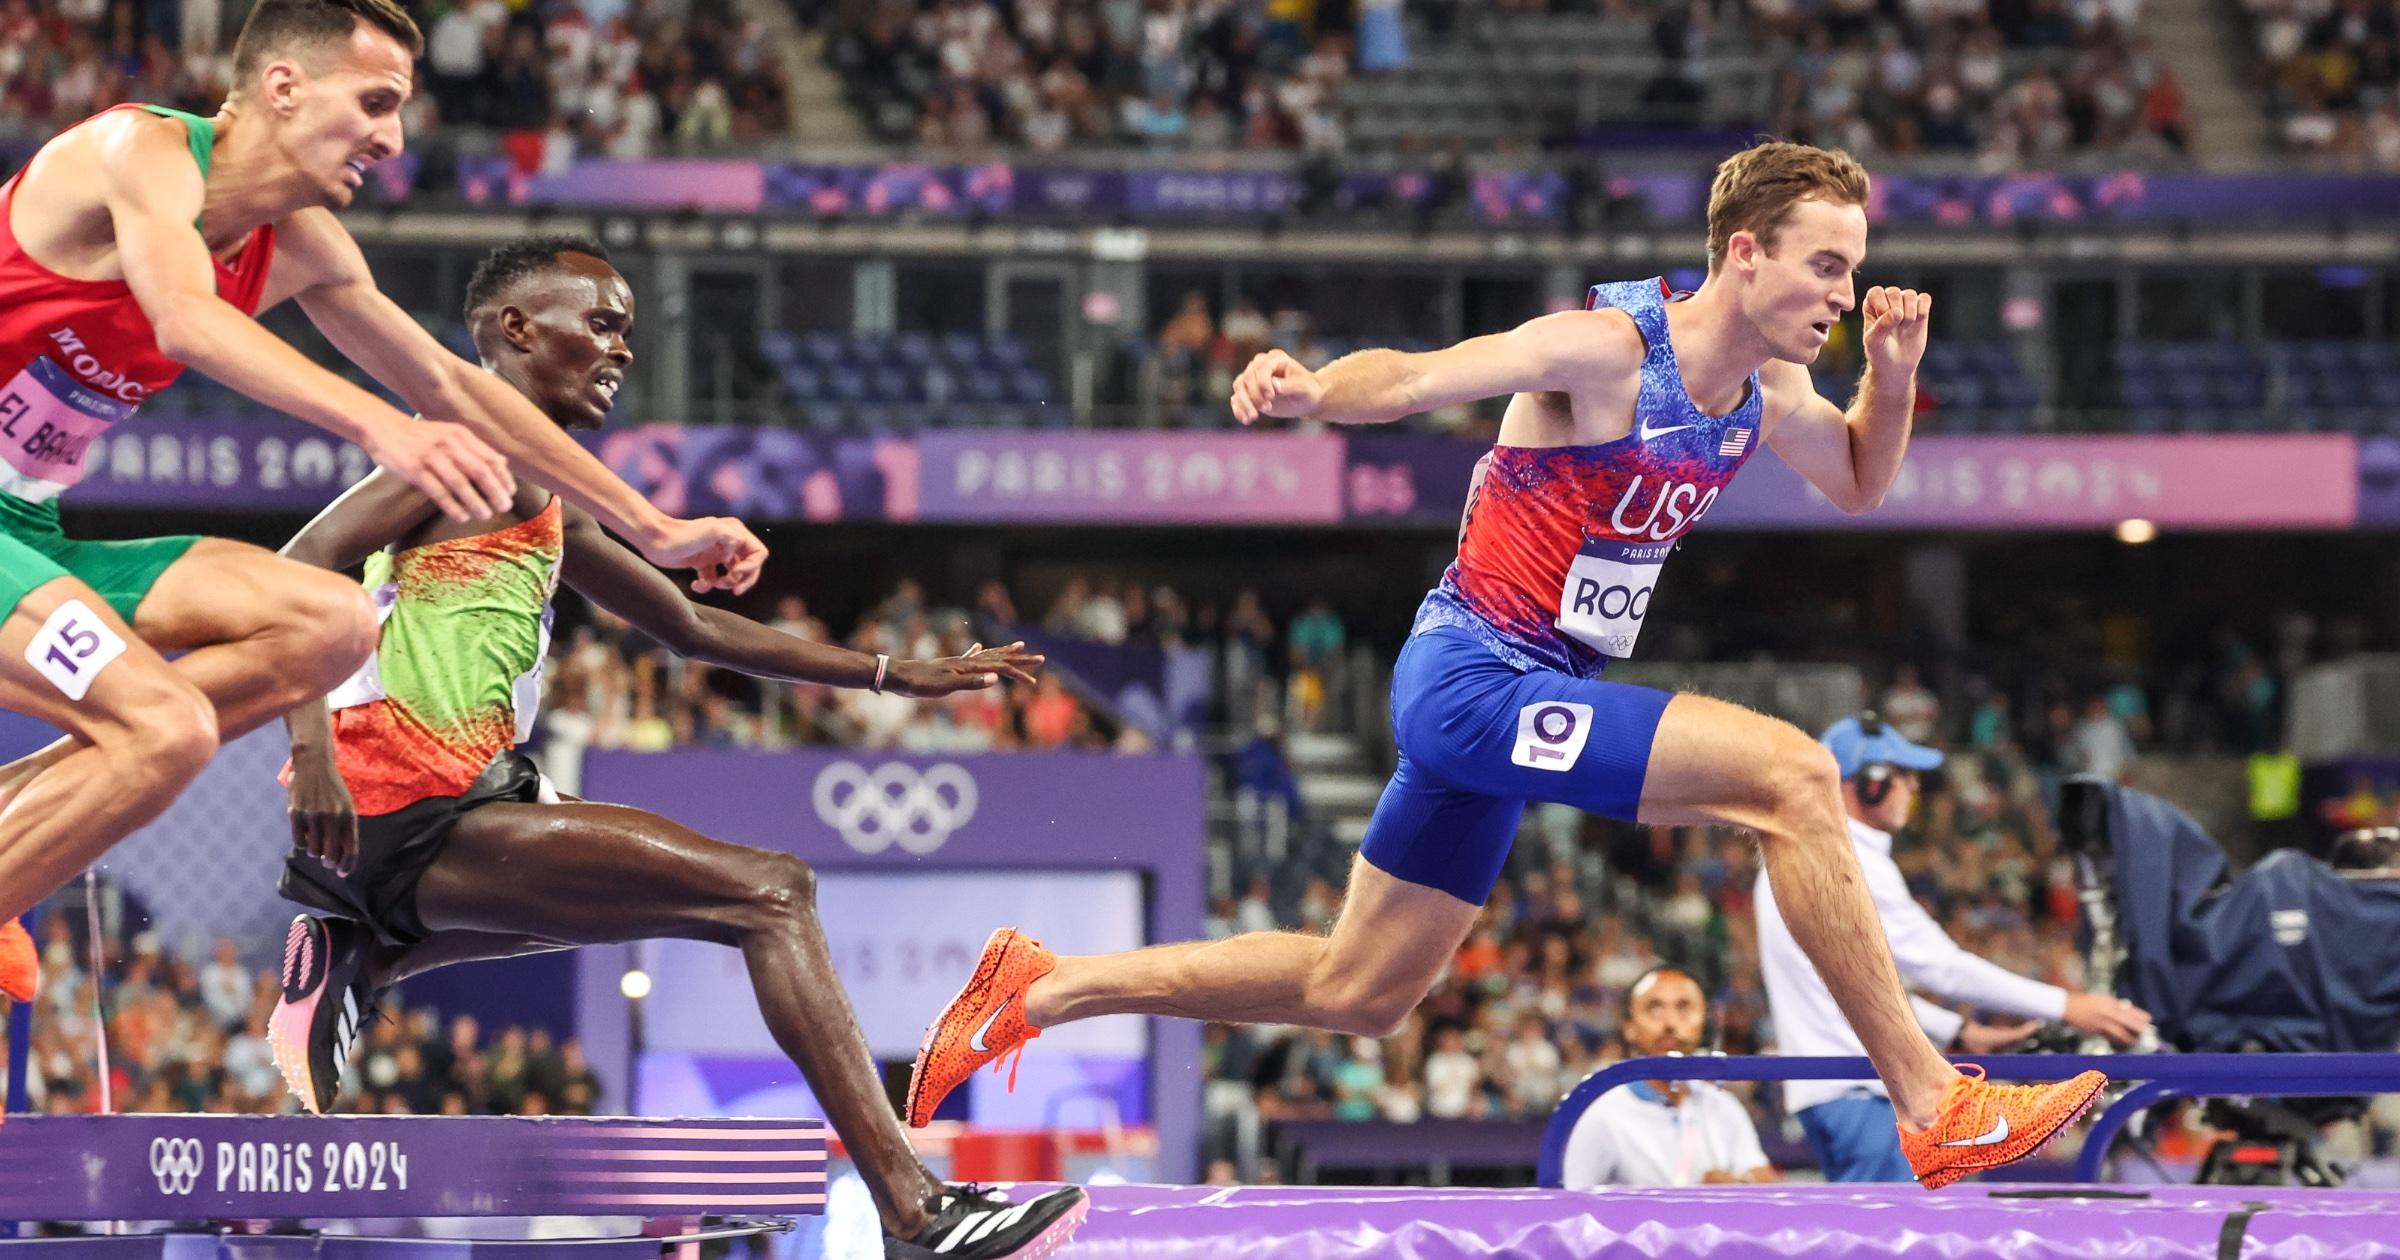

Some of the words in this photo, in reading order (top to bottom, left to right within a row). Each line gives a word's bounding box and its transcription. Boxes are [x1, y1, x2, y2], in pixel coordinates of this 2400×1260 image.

[1145, 451, 1298, 500] 2024
[46, 618, 100, 675] 15
[1529, 706, 1576, 762] 10
[322, 1141, 408, 1193] 2024
